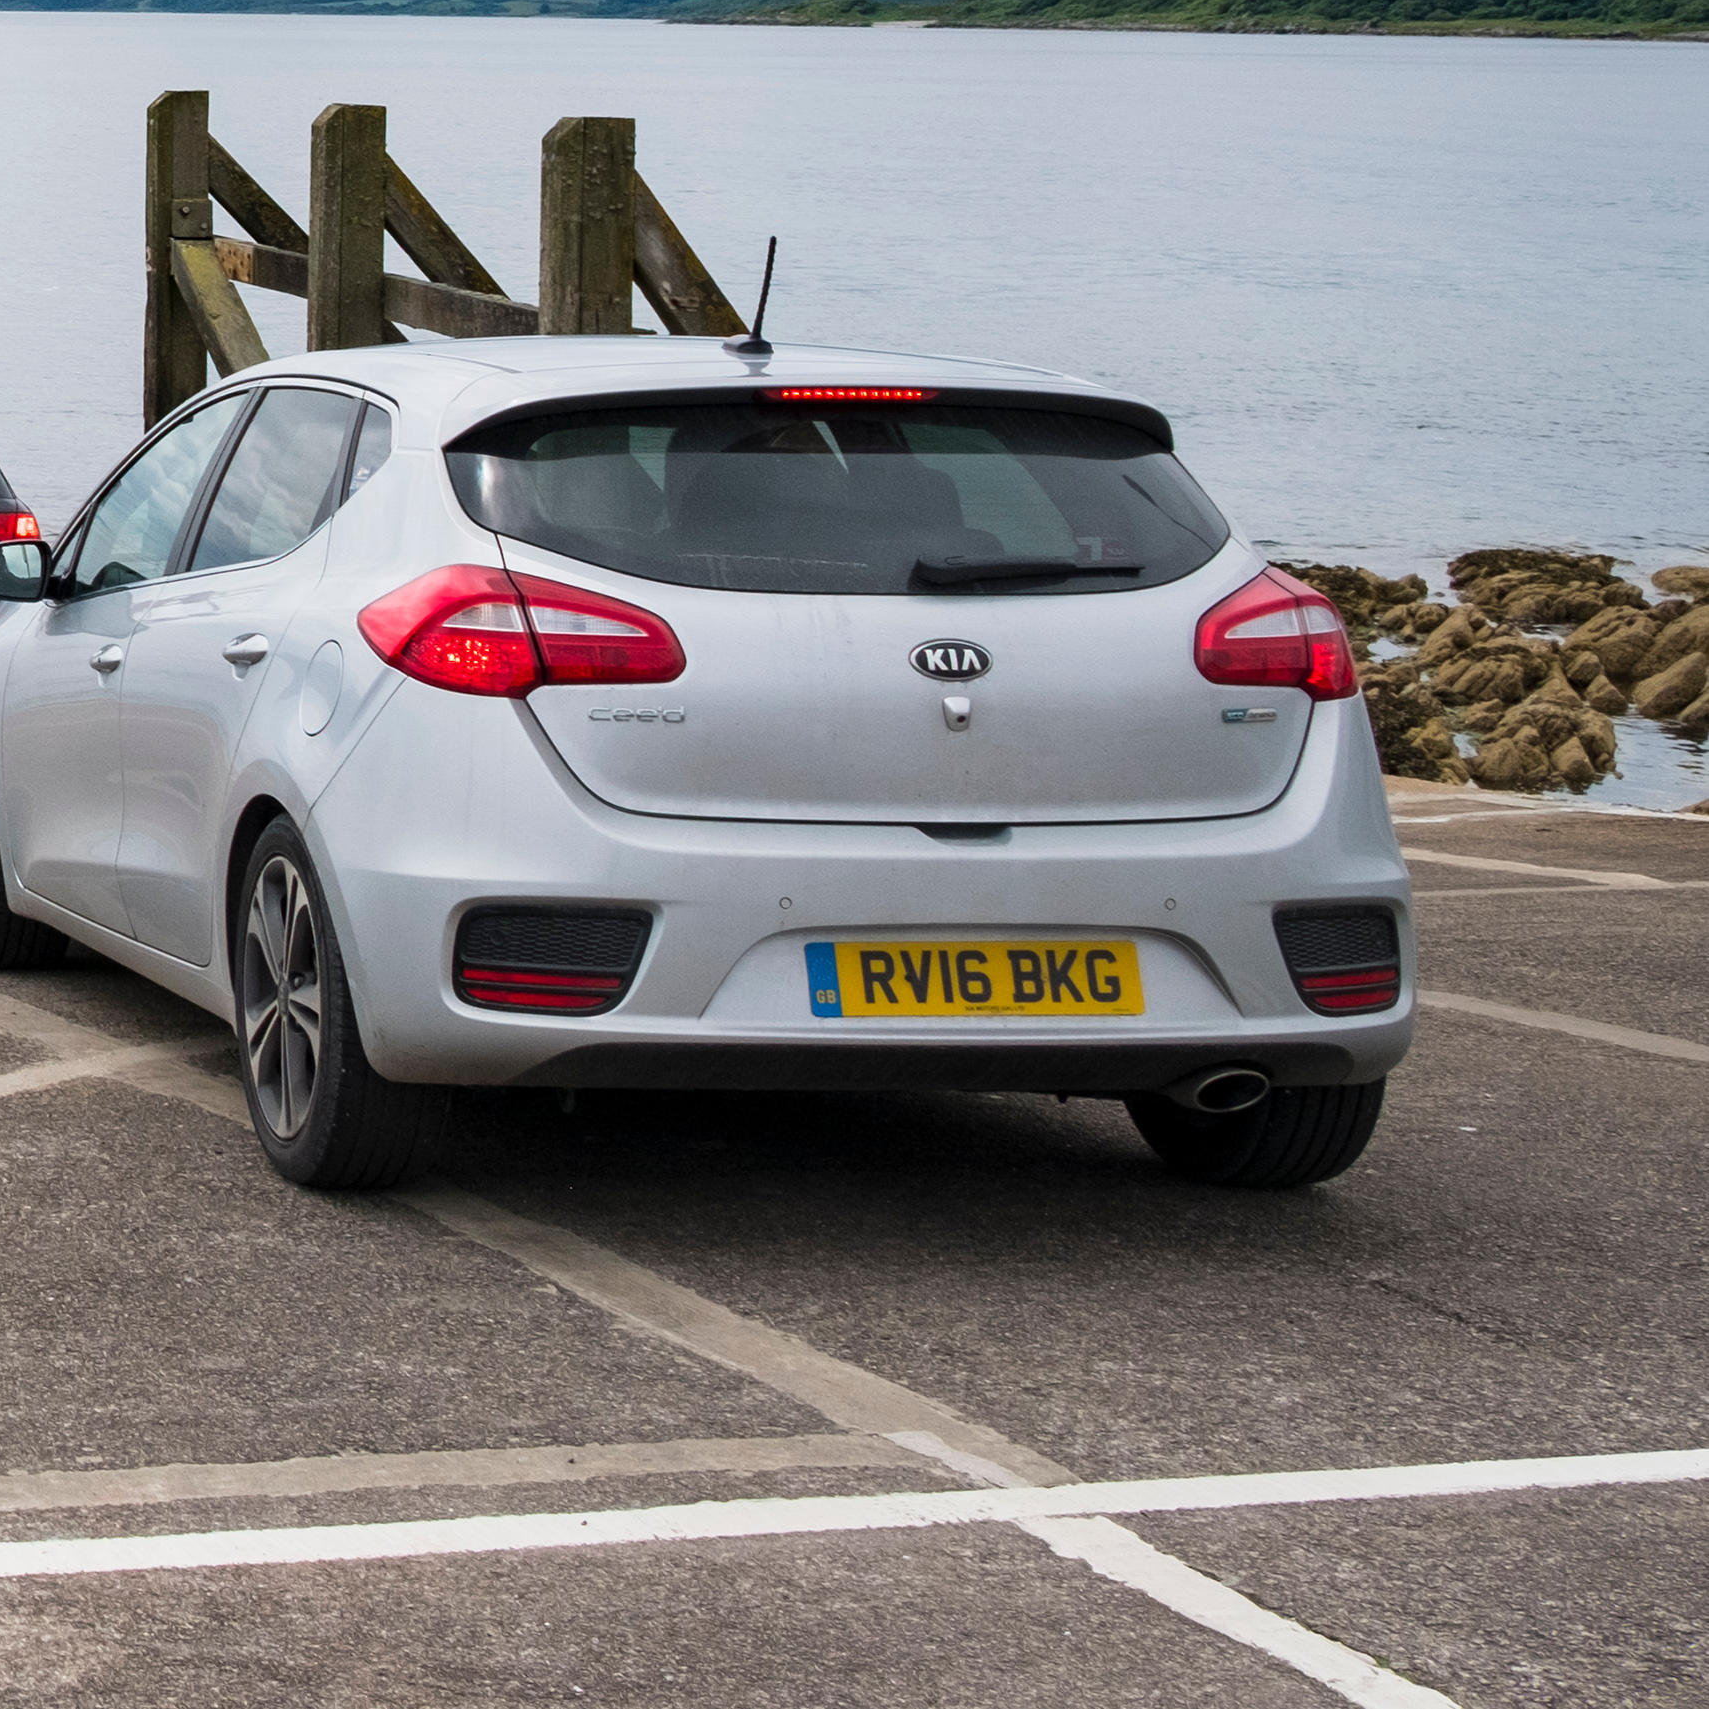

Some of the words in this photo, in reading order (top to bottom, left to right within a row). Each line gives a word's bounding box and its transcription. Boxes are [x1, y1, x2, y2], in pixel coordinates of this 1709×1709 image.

[923, 648, 982, 671] KIA
[860, 950, 993, 1004] RV16
[1007, 950, 1122, 1004] BKG
[815, 990, 838, 1005] GB
